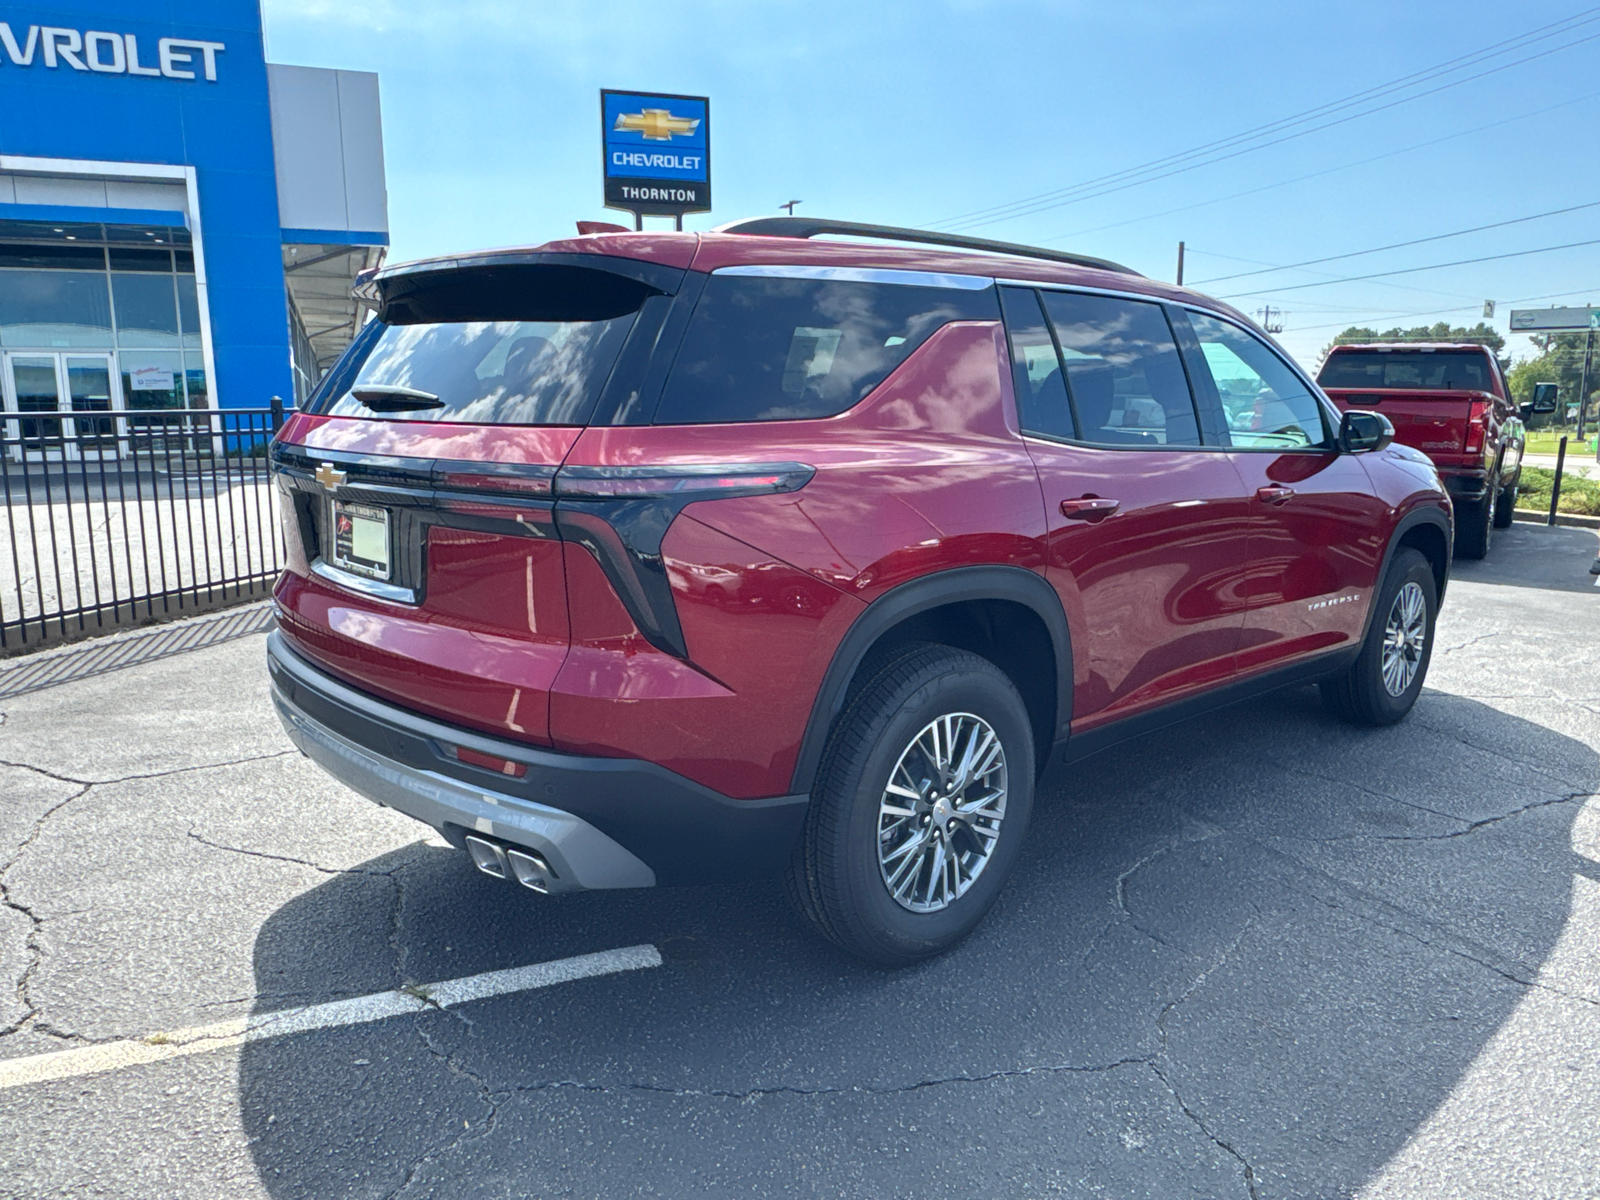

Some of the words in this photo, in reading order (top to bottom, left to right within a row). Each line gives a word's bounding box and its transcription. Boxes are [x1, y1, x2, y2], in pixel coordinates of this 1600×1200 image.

[612, 152, 701, 170] CHEVROLET
[622, 186, 696, 202] THORNTON
[1308, 594, 1359, 611] TRAVERSE
